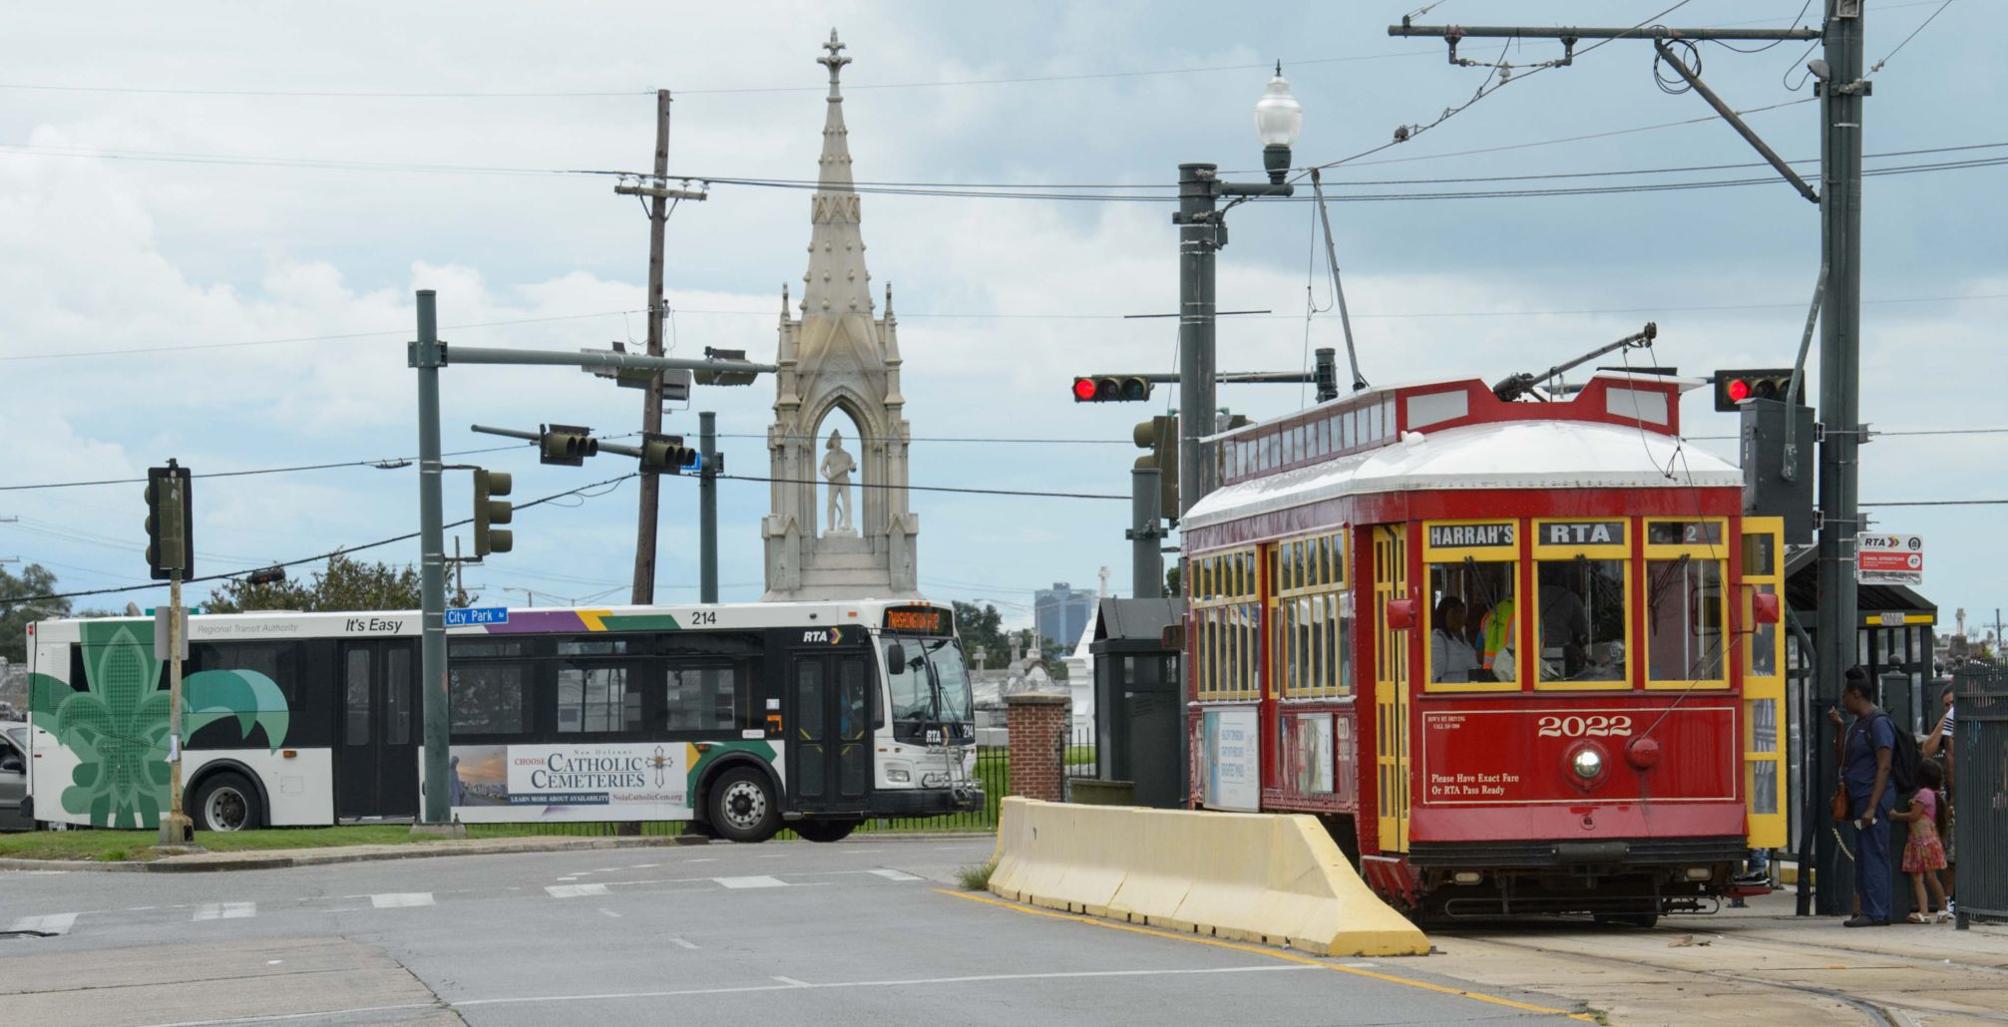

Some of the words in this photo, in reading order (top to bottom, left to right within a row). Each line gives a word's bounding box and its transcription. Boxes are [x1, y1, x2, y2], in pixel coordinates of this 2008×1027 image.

[1430, 526, 1513, 546] HARRAH'S
[1550, 524, 1611, 544] RTA
[1686, 526, 1697, 542] 2
[1865, 538, 1886, 547] RTA
[448, 611, 466, 625] City
[471, 609, 493, 622] Park
[691, 611, 716, 625] 214
[198, 624, 232, 635] Regional
[234, 624, 260, 633] Transit
[262, 623, 299, 634] Authority
[346, 619, 365, 632] It's
[369, 618, 403, 634] Easy
[803, 631, 828, 643] RTA
[963, 724, 974, 738] 214
[1538, 715, 1632, 737] 2022
[926, 730, 941, 743] RTA
[514, 758, 545, 766] CHOOSE
[547, 753, 642, 773] CATHOLIC
[531, 769, 645, 789] CEMETERIES
[1431, 774, 1454, 783] Please
[1457, 774, 1475, 782] Have
[1478, 773, 1500, 782] Exact
[1502, 773, 1519, 782] Fare
[1432, 786, 1441, 795] Or
[1444, 786, 1460, 794] RTA
[1463, 786, 1479, 794] Pass
[1482, 785, 1505, 795] Ready
